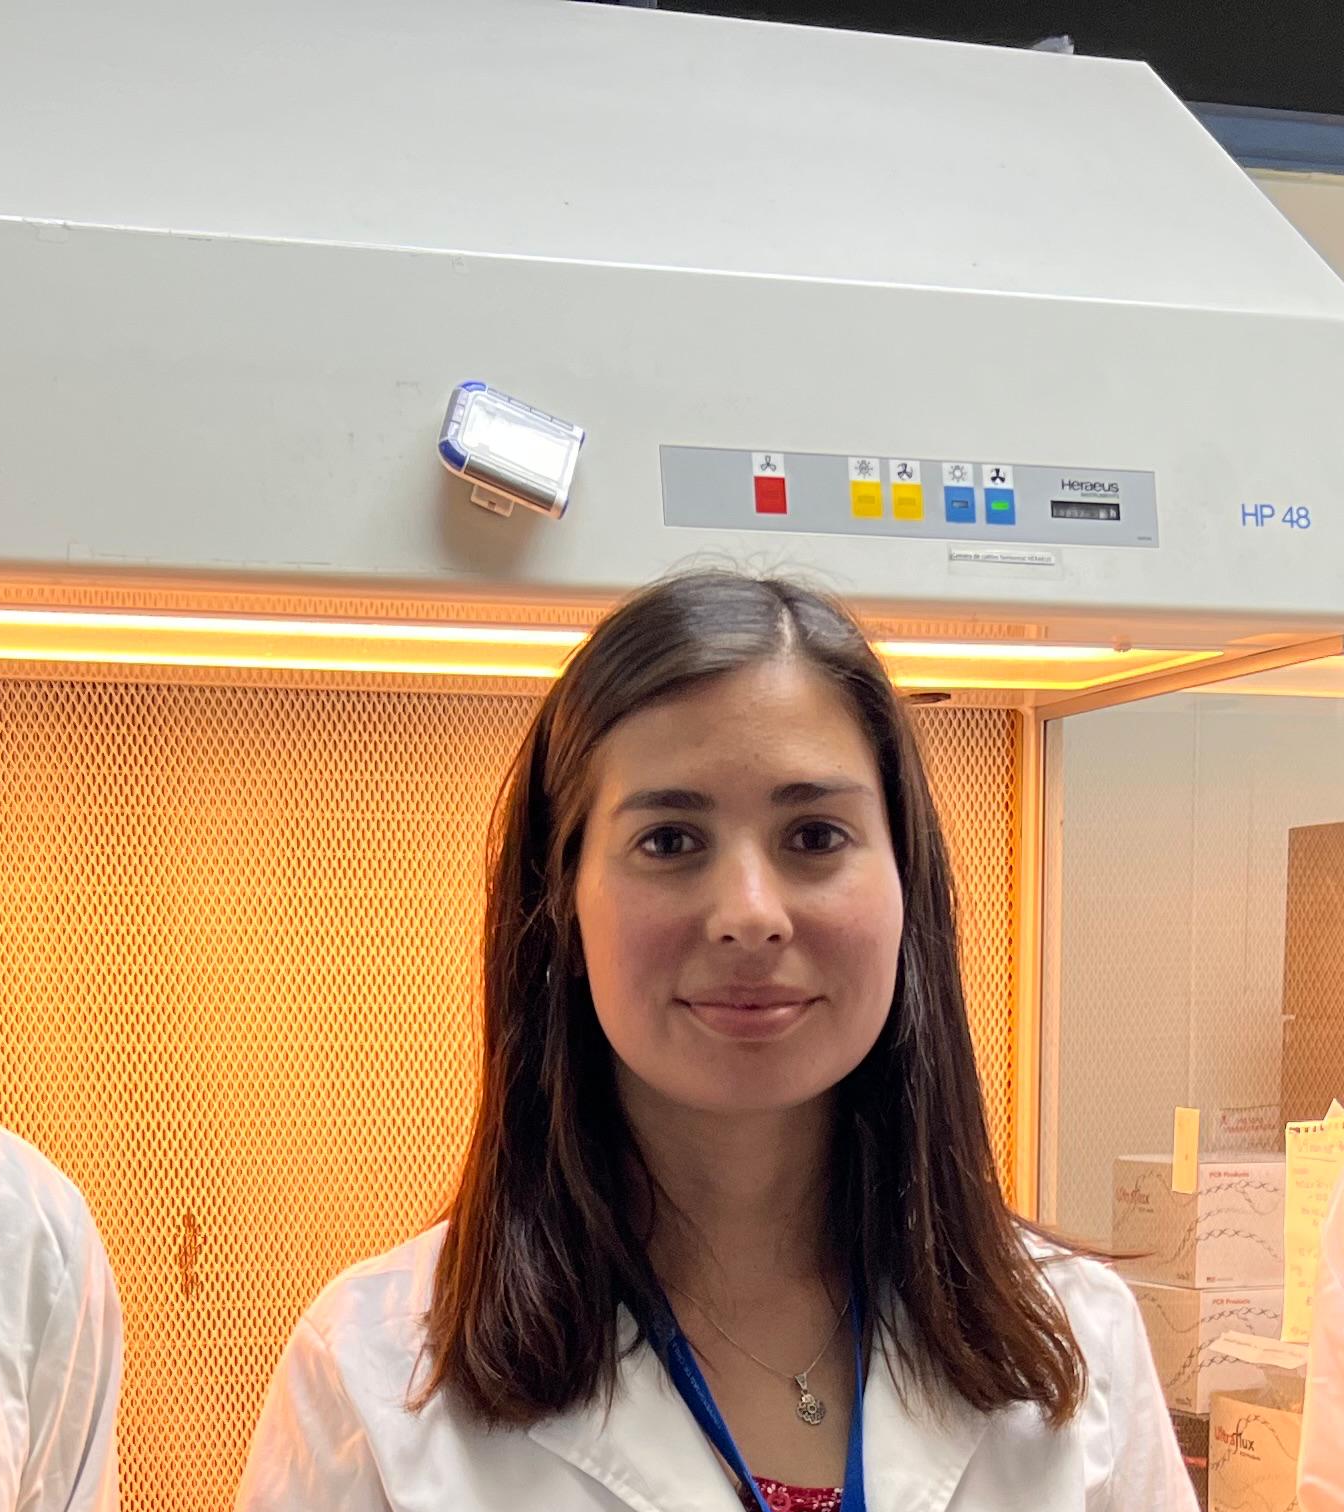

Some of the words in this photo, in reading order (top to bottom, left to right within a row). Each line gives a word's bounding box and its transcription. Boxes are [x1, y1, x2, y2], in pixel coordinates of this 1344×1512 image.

[1061, 479, 1120, 493] Heraeus
[1241, 503, 1276, 527] HP
[1281, 506, 1311, 529] 48
